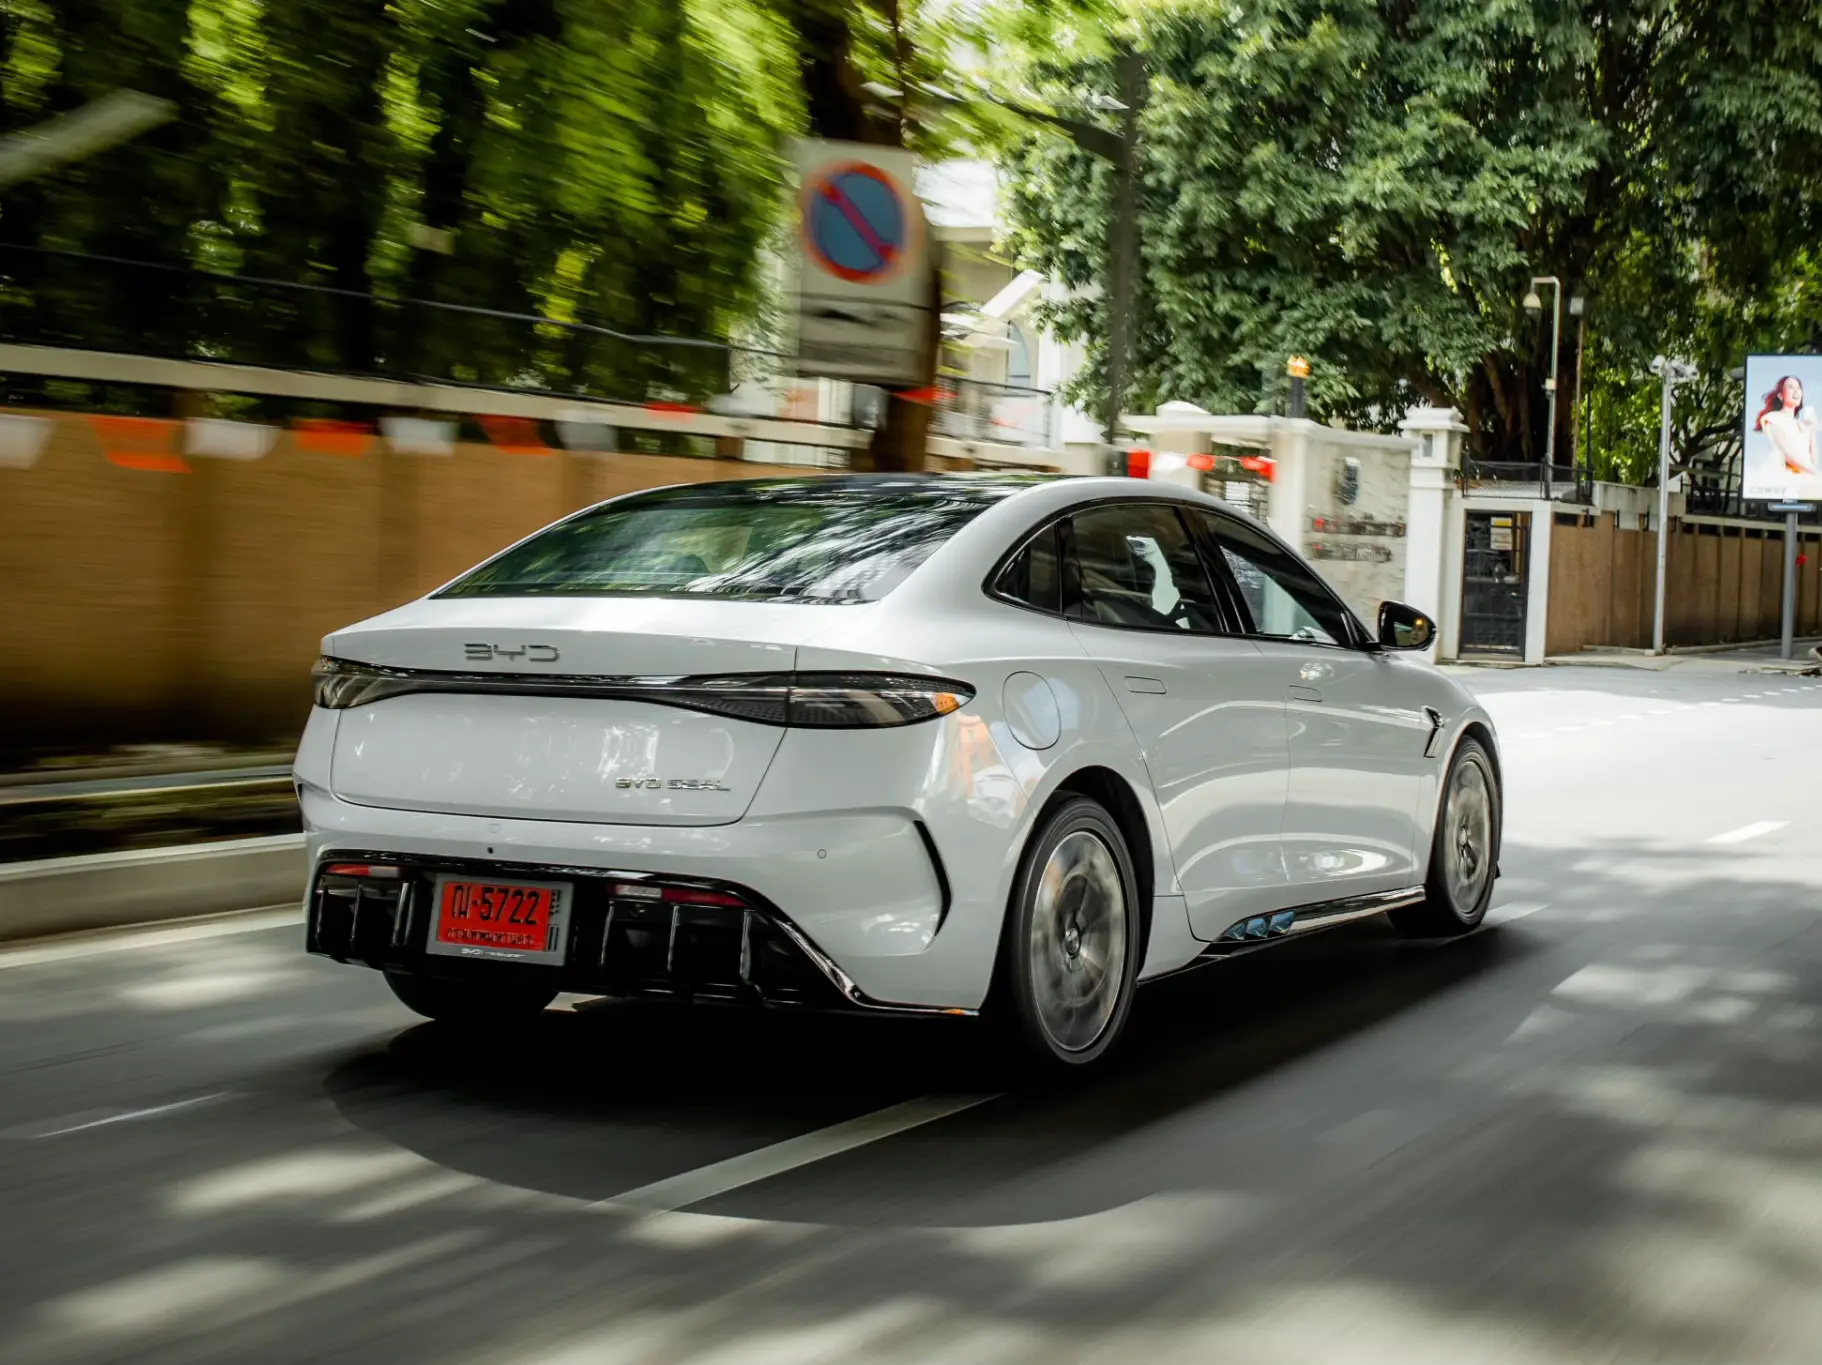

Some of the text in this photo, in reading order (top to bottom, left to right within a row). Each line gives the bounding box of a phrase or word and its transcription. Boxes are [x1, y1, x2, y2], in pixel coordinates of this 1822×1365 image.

[464, 643, 560, 662] BYD
[616, 777, 731, 792] BYD SEAL
